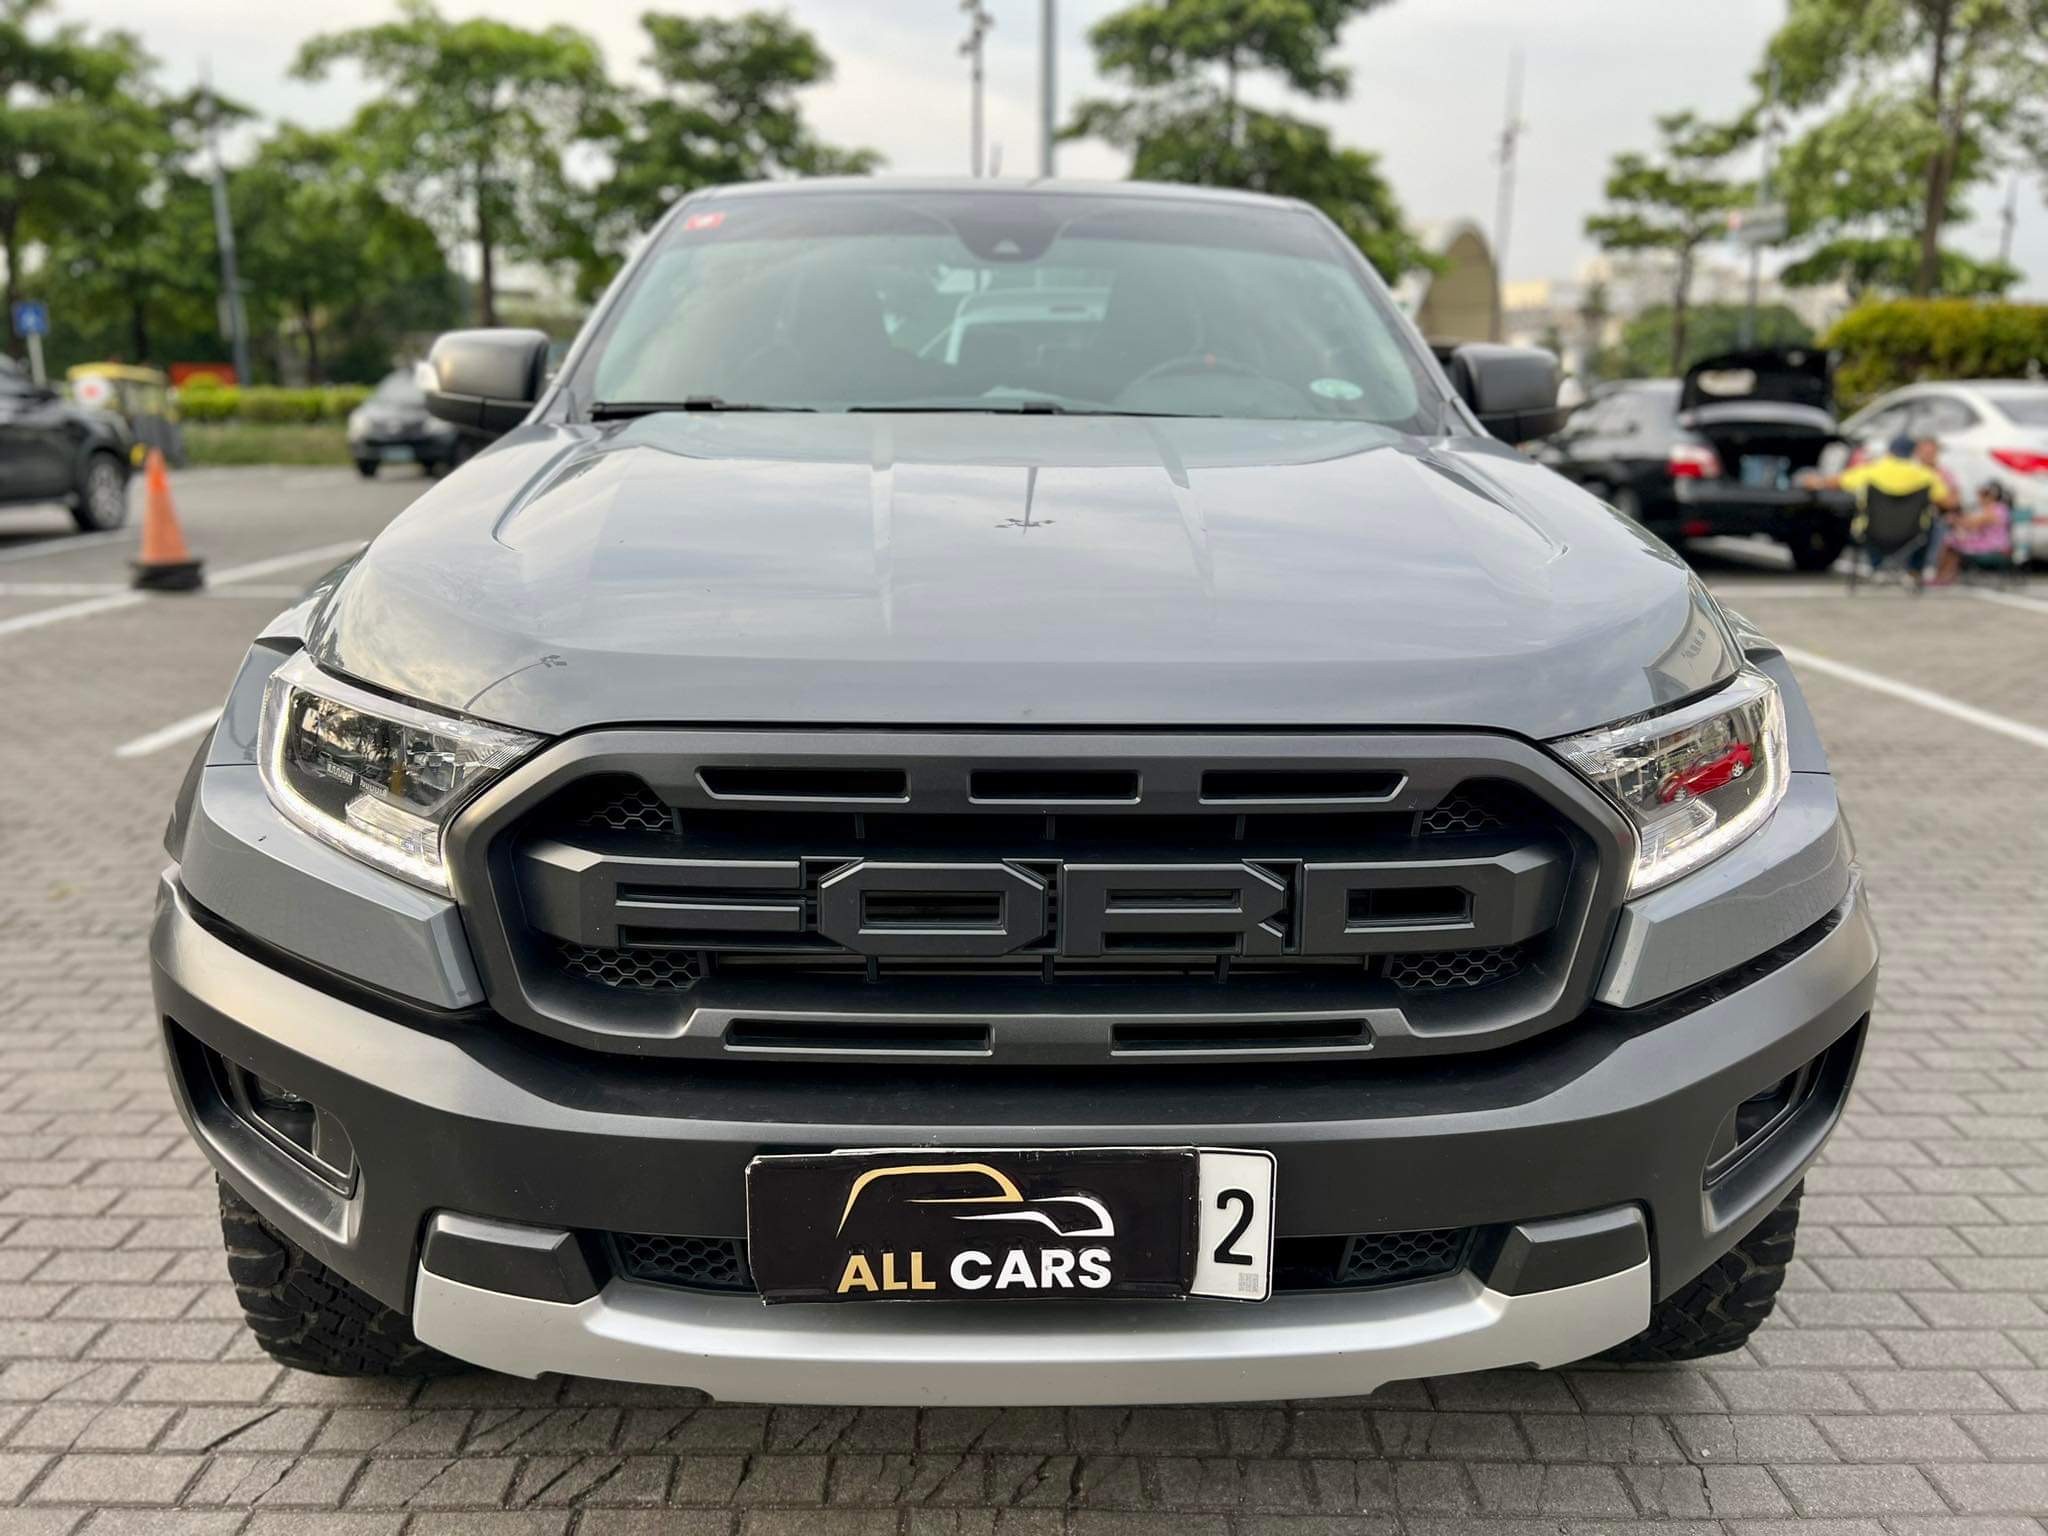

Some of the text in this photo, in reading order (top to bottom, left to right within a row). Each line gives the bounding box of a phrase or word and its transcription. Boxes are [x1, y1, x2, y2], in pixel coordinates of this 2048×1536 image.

[522, 842, 1558, 957] FORD
[1214, 1188, 1254, 1266] 2
[837, 1248, 1112, 1293] ALL CARS
